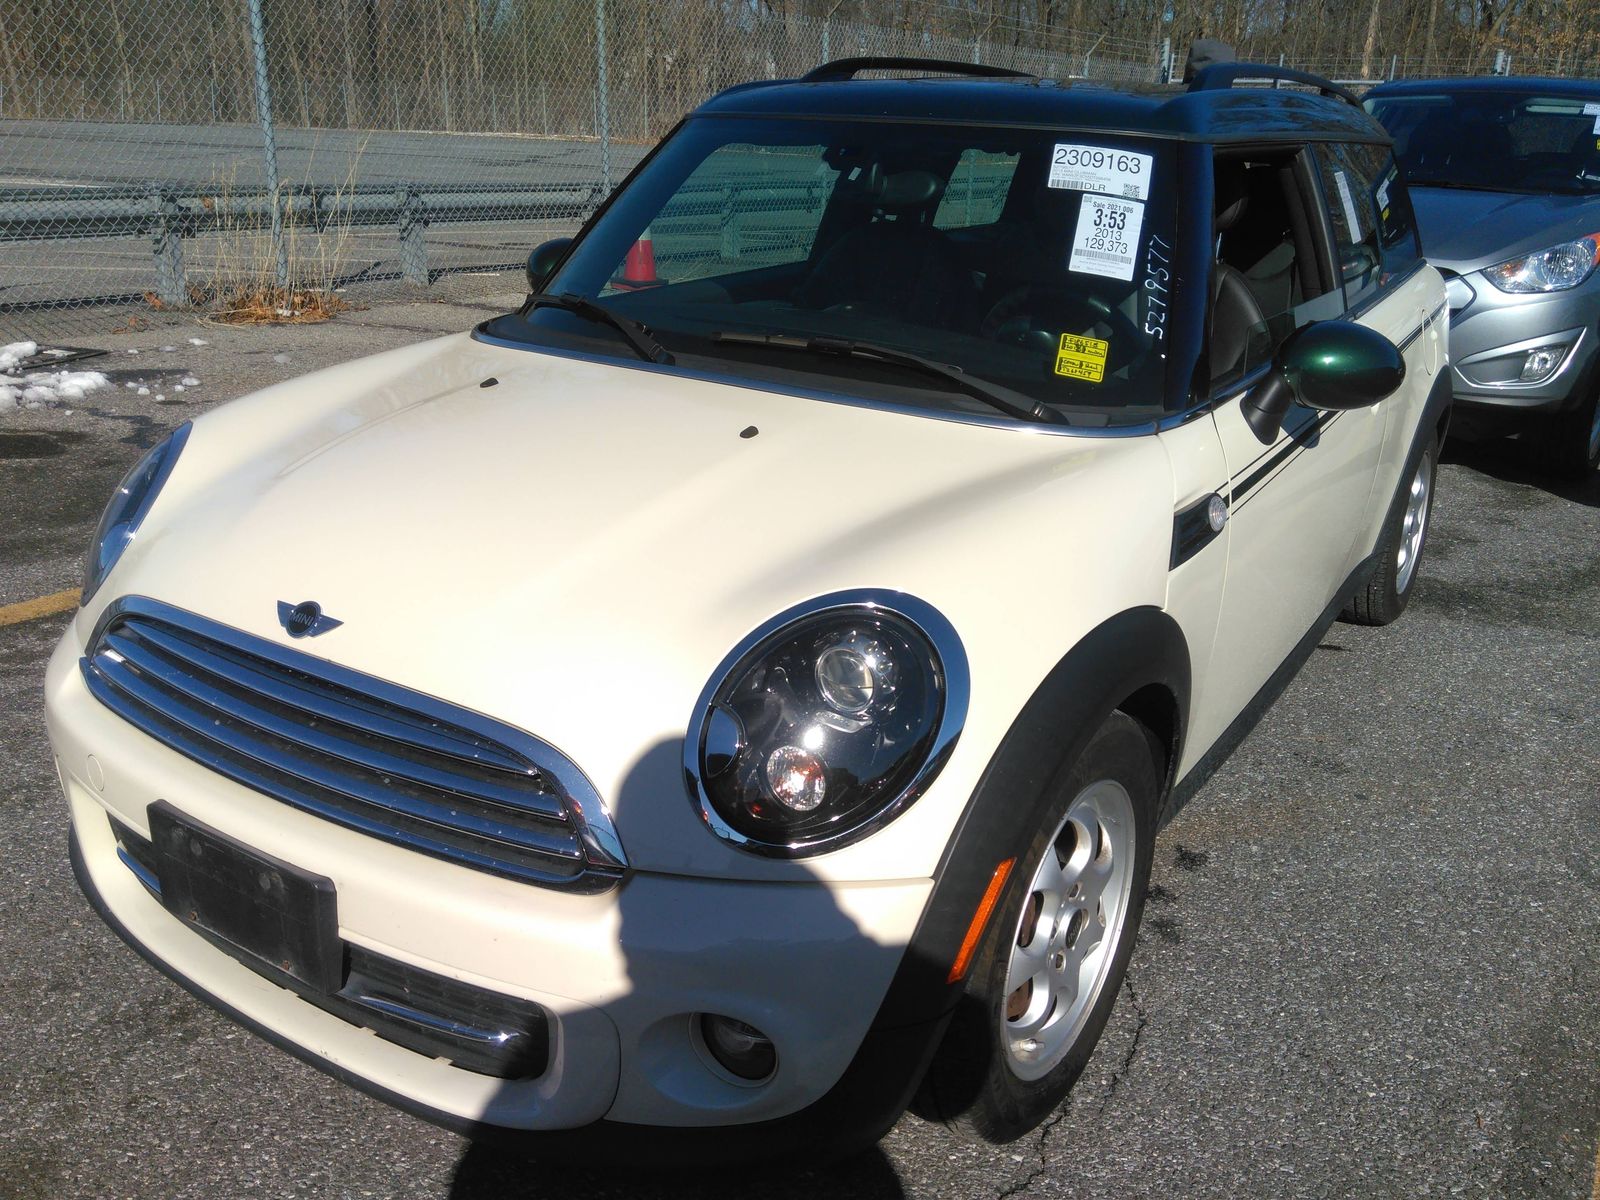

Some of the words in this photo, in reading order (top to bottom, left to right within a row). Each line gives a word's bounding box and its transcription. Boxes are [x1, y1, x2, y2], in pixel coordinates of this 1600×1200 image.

[1054, 148, 1141, 174] 2309163
[1084, 182, 1106, 192] DLR
[1093, 201, 1106, 210] Sale
[1107, 203, 1121, 211] 2021
[1094, 208, 1127, 231] 3:53
[1095, 227, 1122, 241] 2013
[1085, 236, 1128, 255] 129,373
[1144, 234, 1171, 340] 5279577
[291, 609, 315, 627] MINI
